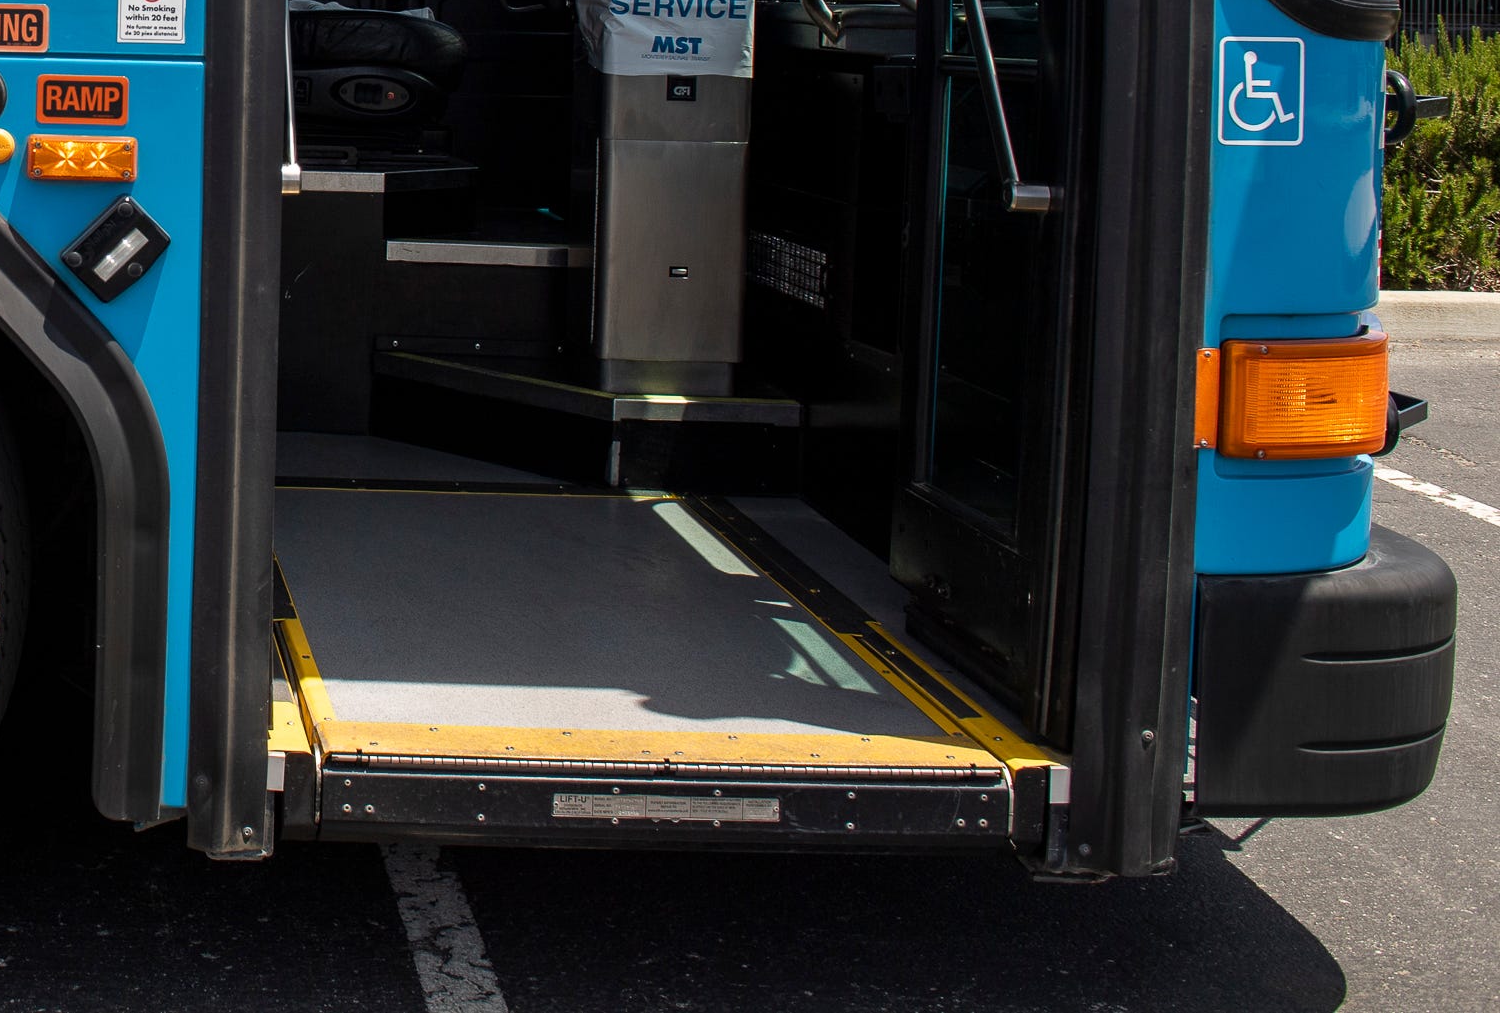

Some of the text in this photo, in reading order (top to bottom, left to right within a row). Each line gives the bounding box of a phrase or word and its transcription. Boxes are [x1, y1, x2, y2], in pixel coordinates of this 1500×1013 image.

[142, 4, 176, 13] Smoking
[151, 14, 161, 22] 20
[162, 14, 178, 22] feet
[651, 35, 702, 55] MST
[45, 85, 120, 112] RAMP
[559, 795, 587, 803] LIFT-U
